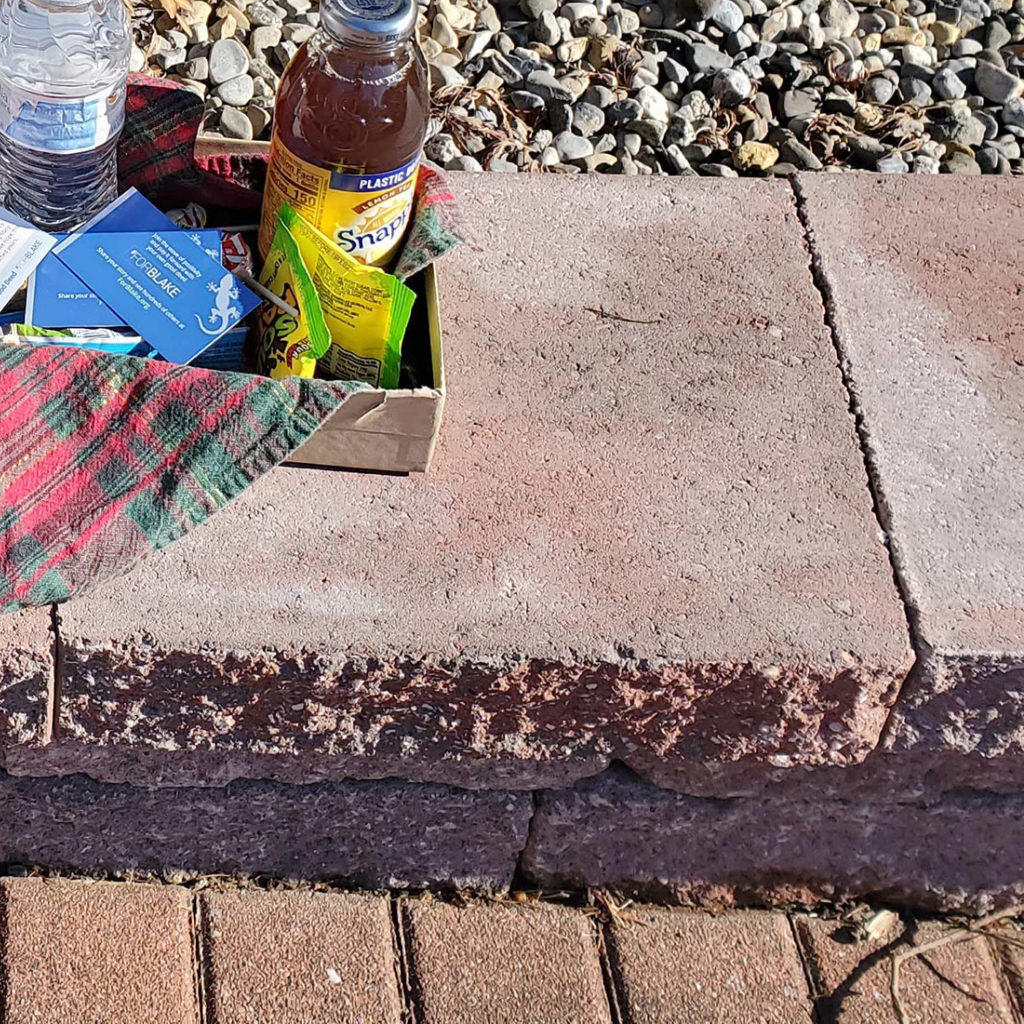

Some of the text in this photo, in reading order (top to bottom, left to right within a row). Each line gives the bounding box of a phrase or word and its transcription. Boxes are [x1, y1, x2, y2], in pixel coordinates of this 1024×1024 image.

[359, 171, 404, 189] PLASTIC
[294, 190, 316, 206] 150
[362, 190, 395, 211] LEMON
[160, 240, 168, 248] the
[3, 270, 16, 284] Deed
